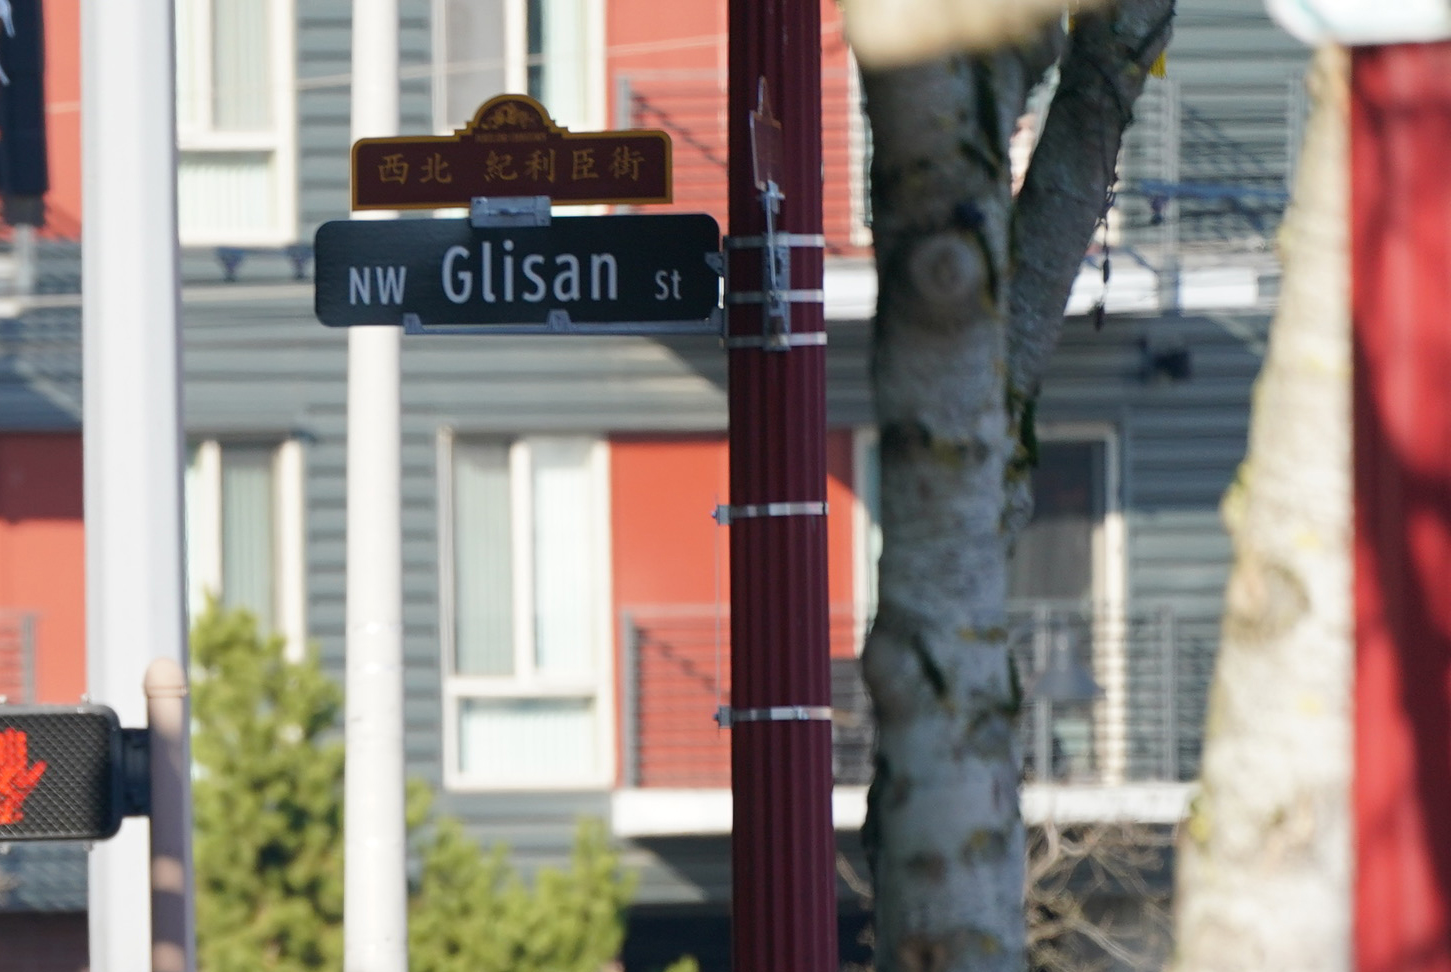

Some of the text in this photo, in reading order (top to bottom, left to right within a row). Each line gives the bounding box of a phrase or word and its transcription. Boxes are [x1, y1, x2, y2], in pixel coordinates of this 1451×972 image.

[377, 152, 453, 185] 西北
[349, 266, 407, 306] NW
[442, 239, 619, 304] Glisan
